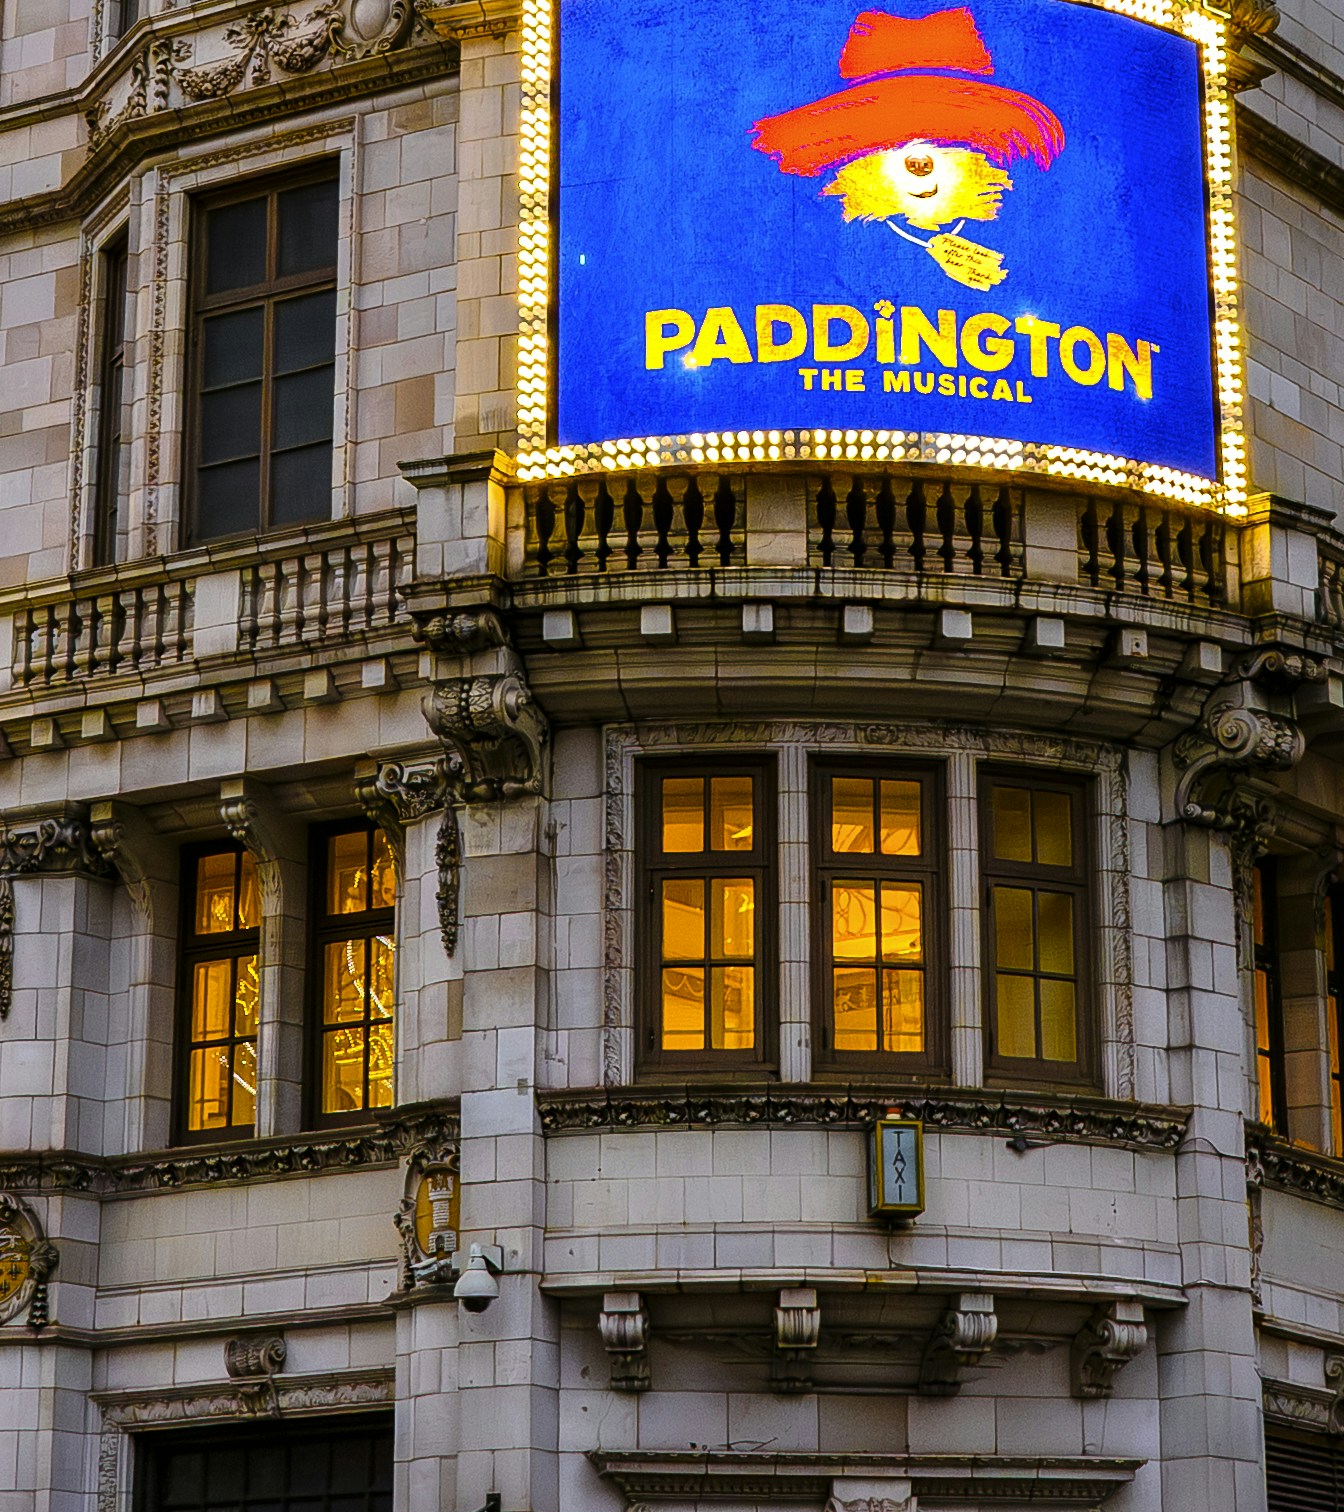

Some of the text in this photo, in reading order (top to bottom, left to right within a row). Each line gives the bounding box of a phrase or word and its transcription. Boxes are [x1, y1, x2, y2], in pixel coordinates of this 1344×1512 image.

[644, 298, 1153, 400] PADDINGTON
[798, 367, 1033, 405] THE MUSICAL
